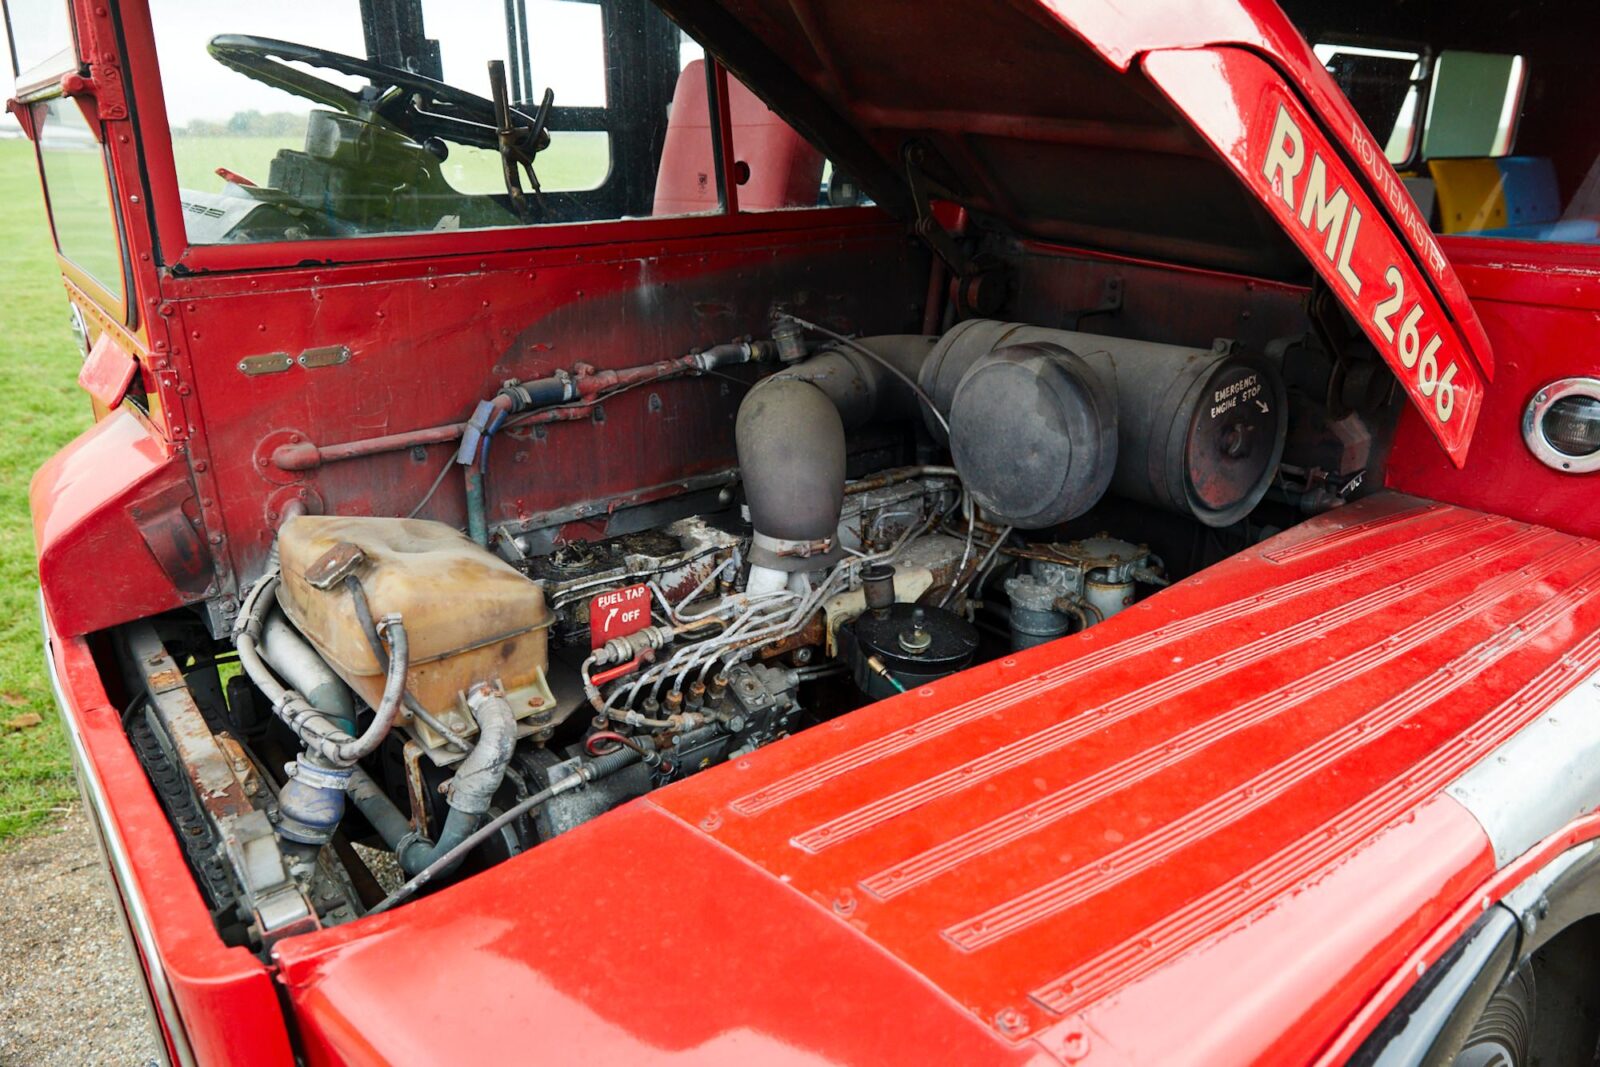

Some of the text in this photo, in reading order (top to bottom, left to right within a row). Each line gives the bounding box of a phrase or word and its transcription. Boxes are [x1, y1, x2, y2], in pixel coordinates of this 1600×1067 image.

[1351, 121, 1445, 280] ROUTEMASTER
[1262, 102, 1459, 423] RML 2666
[1210, 384, 1262, 419] ENGINE STOP
[1215, 374, 1257, 403] EMERGENCY
[597, 586, 645, 608] FUEL TAP
[621, 608, 641, 623] OFF
